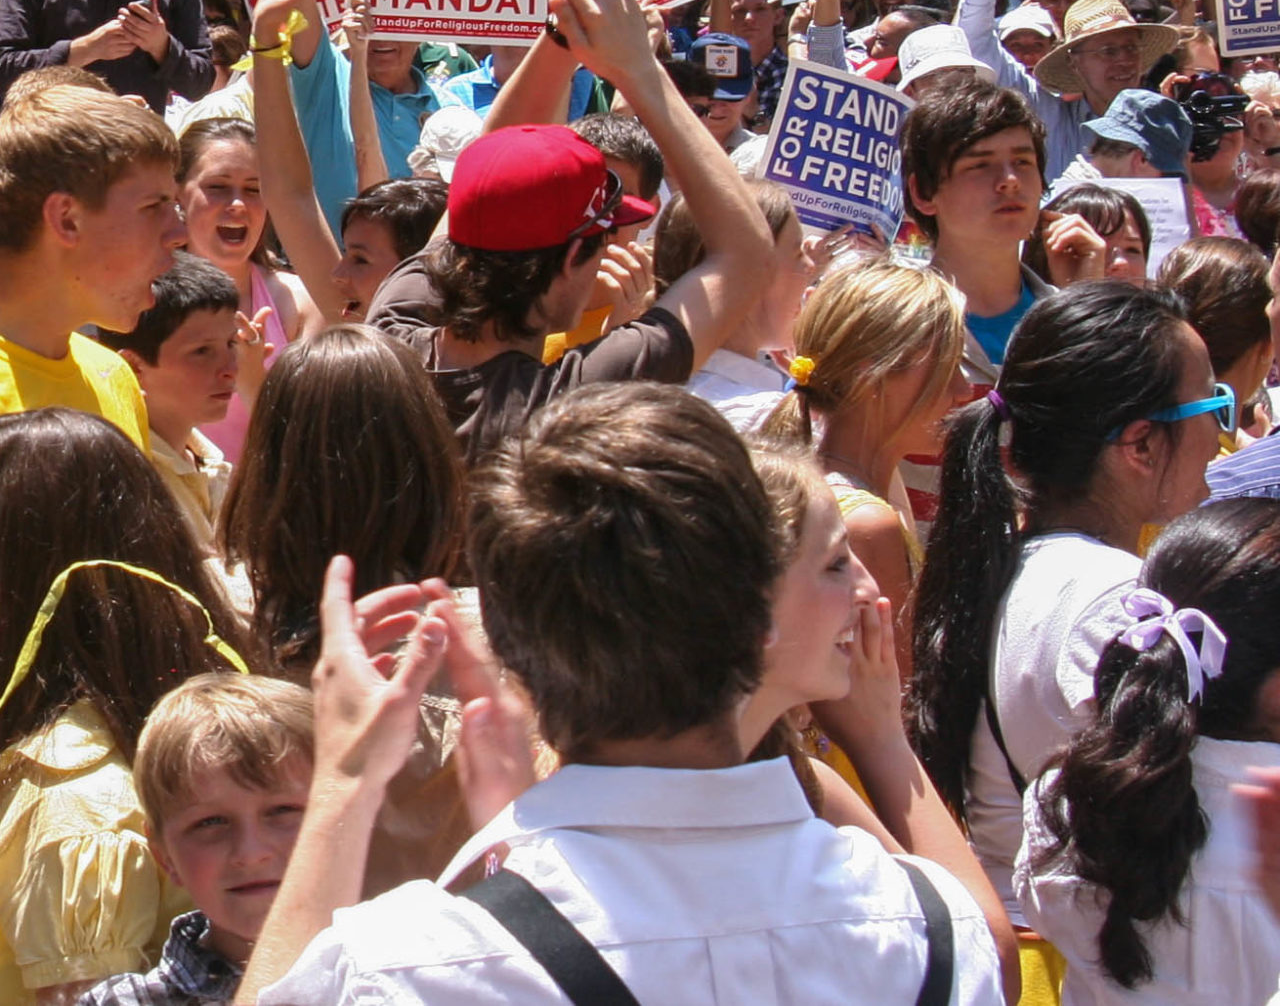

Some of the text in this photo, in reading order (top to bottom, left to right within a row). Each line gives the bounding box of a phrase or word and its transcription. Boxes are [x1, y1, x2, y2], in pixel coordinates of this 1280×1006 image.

[373, 17, 548, 34] tandUpForReligiousFreedom.co
[793, 75, 899, 137] STAND
[772, 116, 809, 178] FOR
[809, 122, 901, 176] RELIGIO
